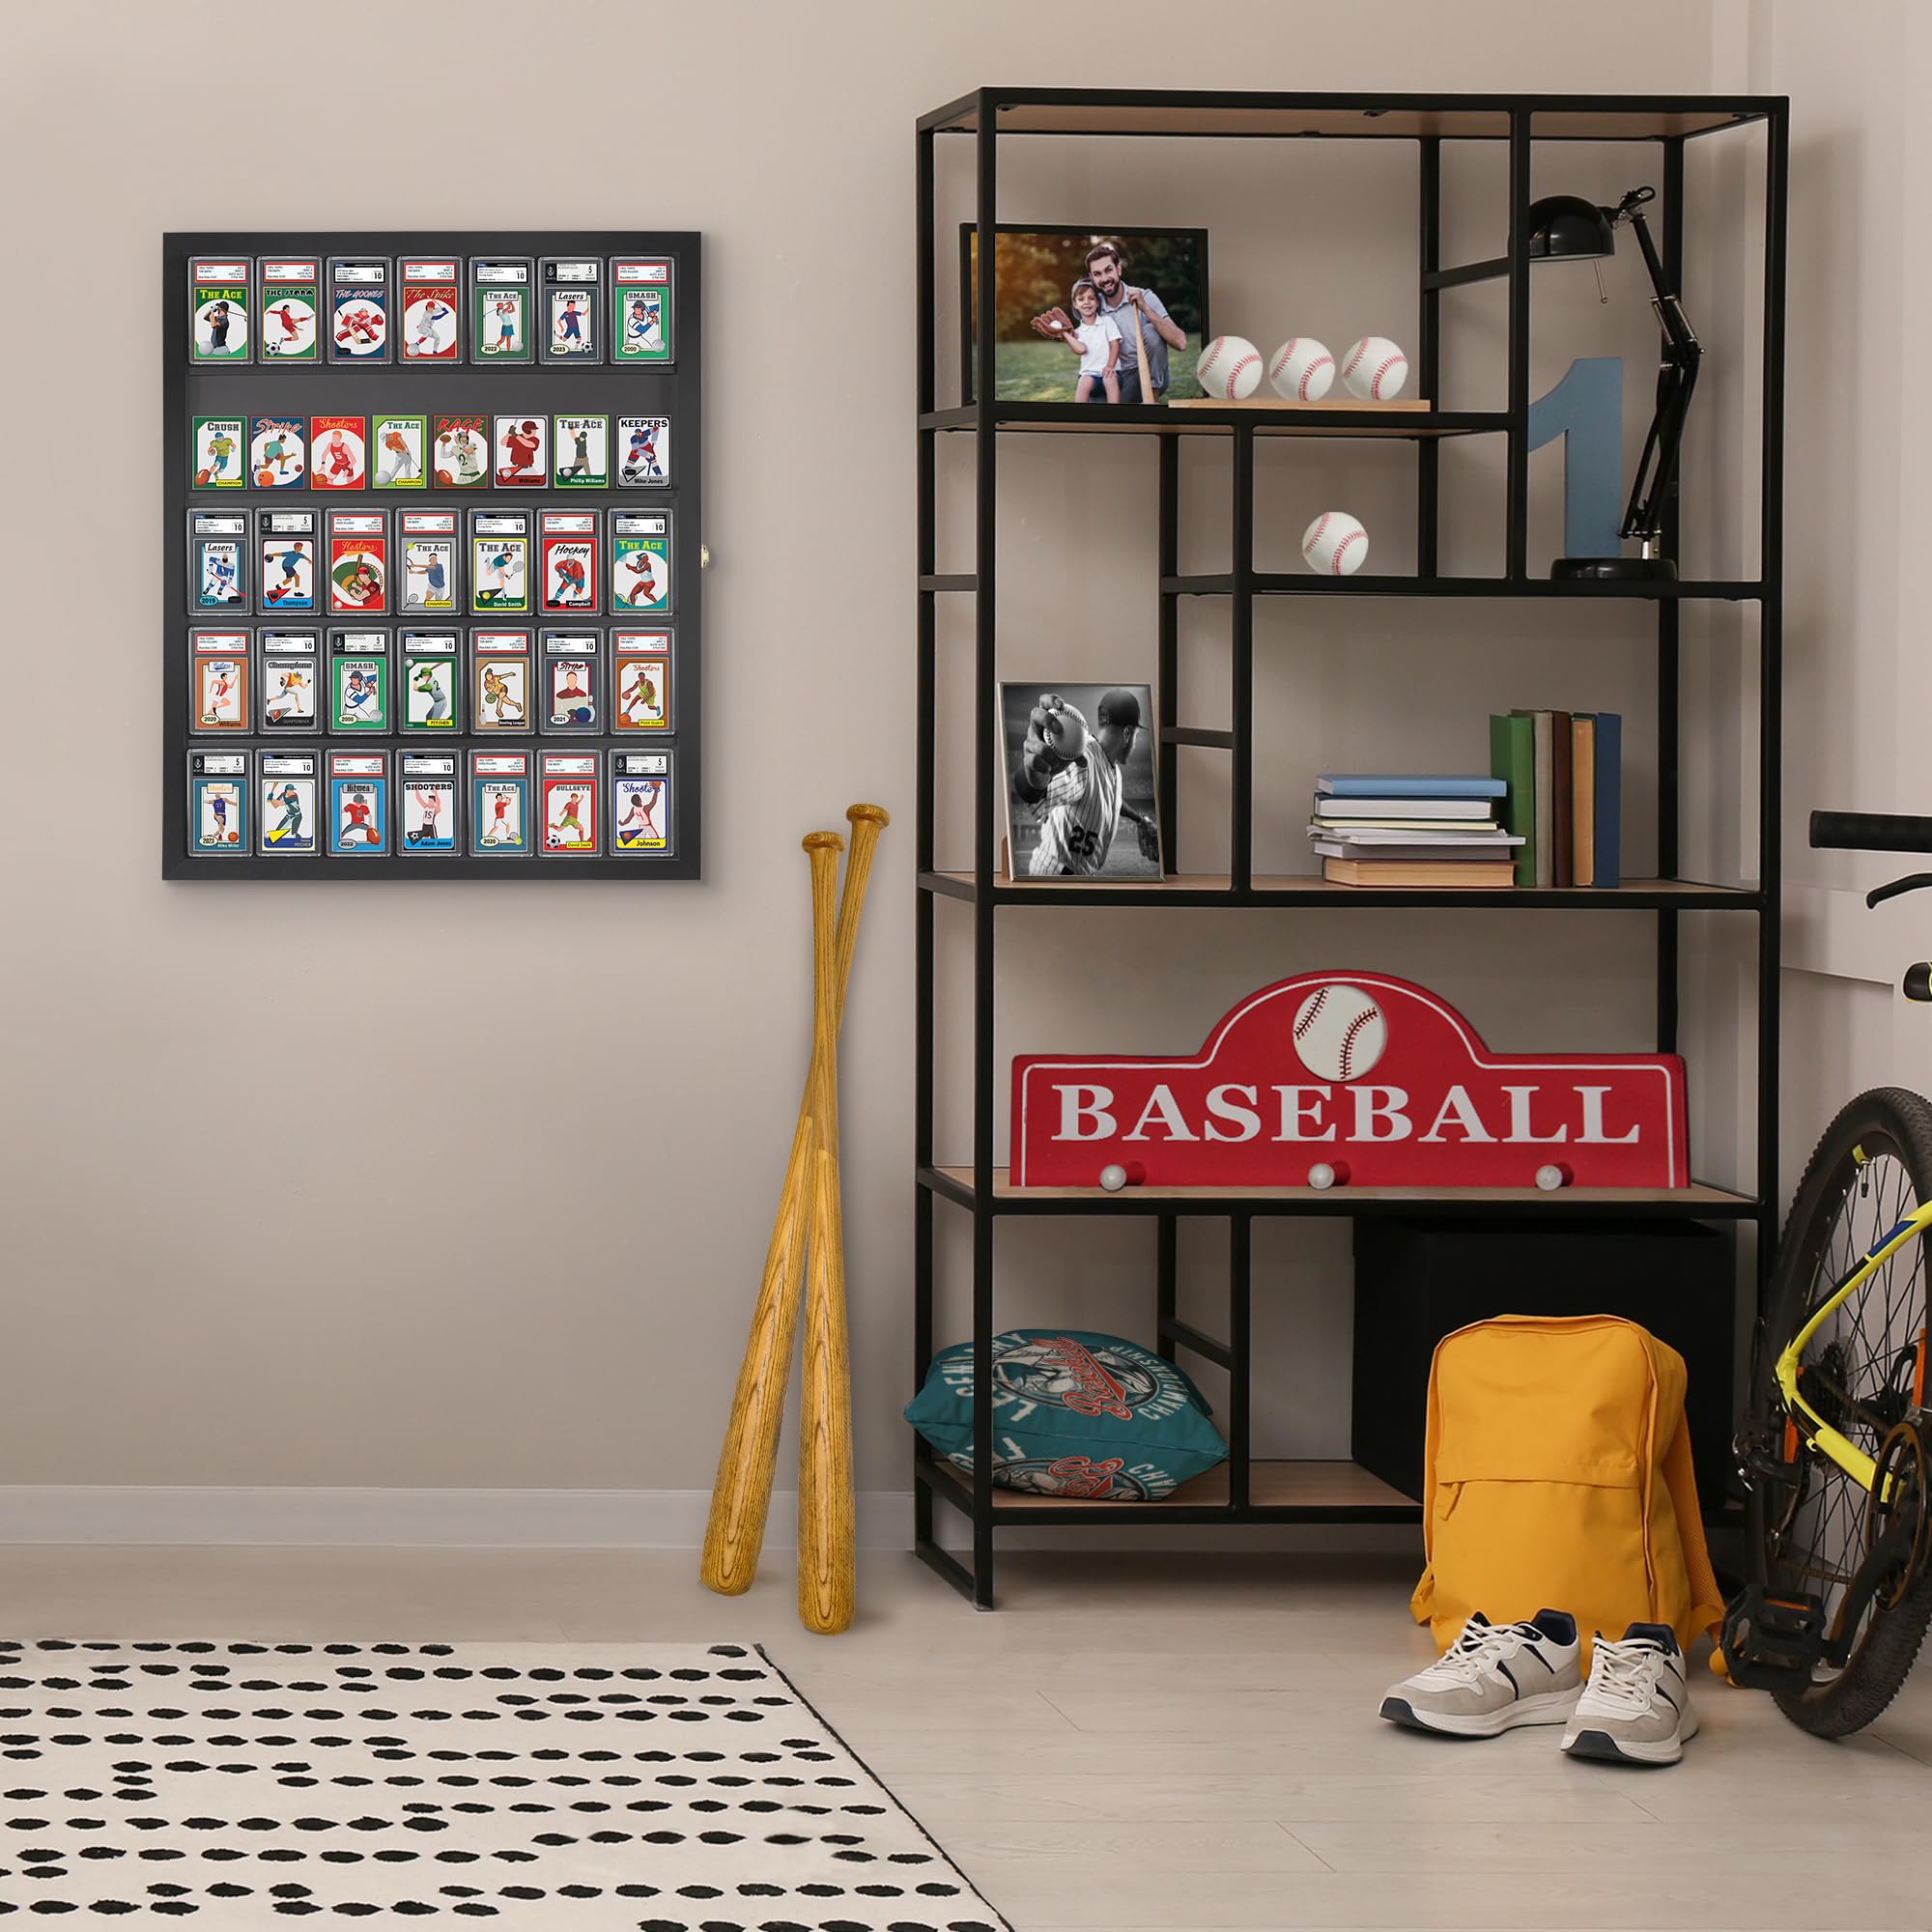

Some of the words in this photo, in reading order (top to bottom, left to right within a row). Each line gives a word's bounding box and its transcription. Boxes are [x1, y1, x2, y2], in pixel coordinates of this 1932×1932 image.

[199, 289, 221, 298] THE
[221, 289, 243, 299] ACE
[207, 422, 240, 432] CRUSH
[437, 418, 485, 435] RAGE
[558, 419, 582, 429] THE
[582, 419, 603, 429] ACE
[620, 419, 668, 428] KEEPERS
[207, 543, 234, 552] Lasers
[478, 543, 499, 553] THE
[500, 543, 521, 553] ACE
[618, 541, 639, 550] THE
[640, 541, 664, 550] ACE
[554, 545, 590, 557] Hockey
[1067, 825, 1099, 857] 25
[1051, 1084, 1640, 1144] BASEBALL
